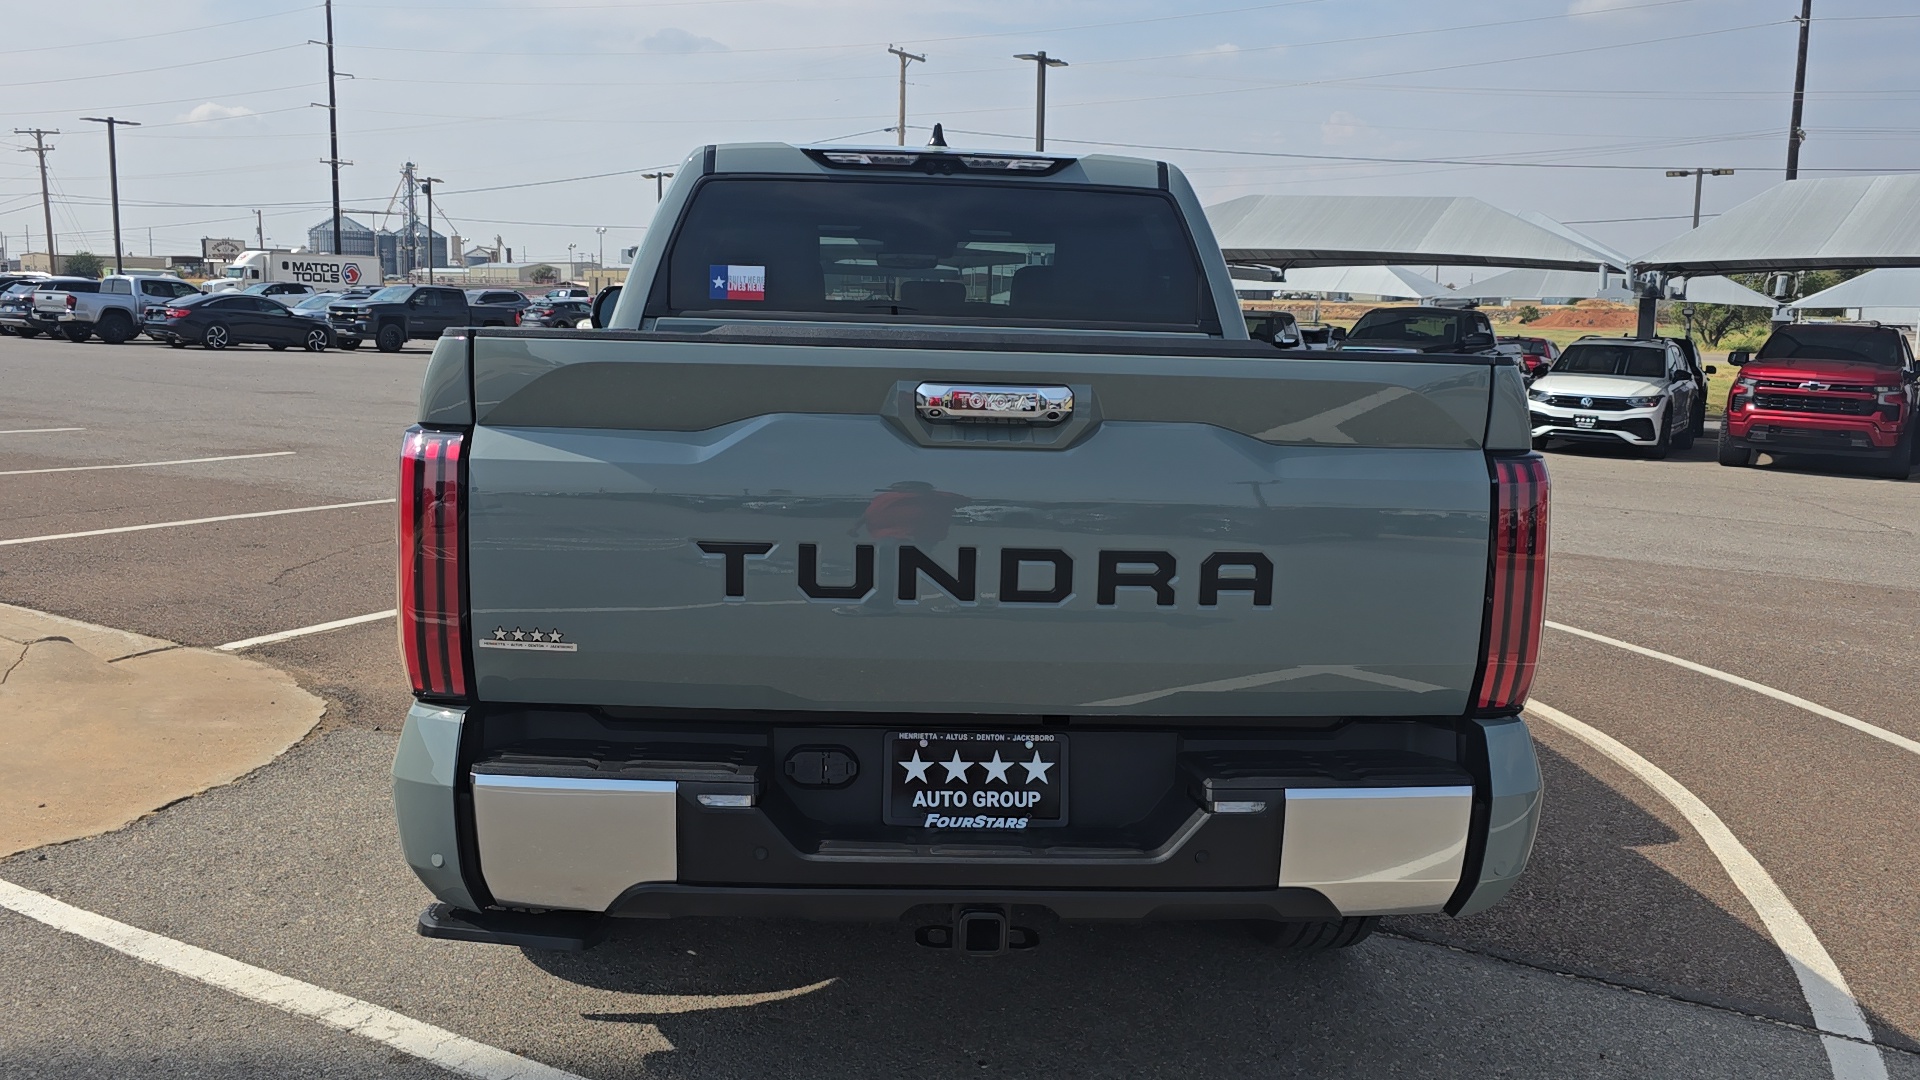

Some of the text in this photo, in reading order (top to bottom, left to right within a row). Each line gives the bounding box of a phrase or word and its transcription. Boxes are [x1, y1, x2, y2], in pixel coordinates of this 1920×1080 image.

[292, 262, 340, 273] MATCO
[293, 272, 340, 283] TOOLS
[748, 283, 765, 292] HERE
[958, 393, 1032, 411] TOYOTA
[696, 540, 1275, 606] TUNDRA
[898, 732, 1055, 742] HENRIETTA ALTUS DENTON JACKSBORO
[912, 790, 1041, 808] AUTO GROUP
